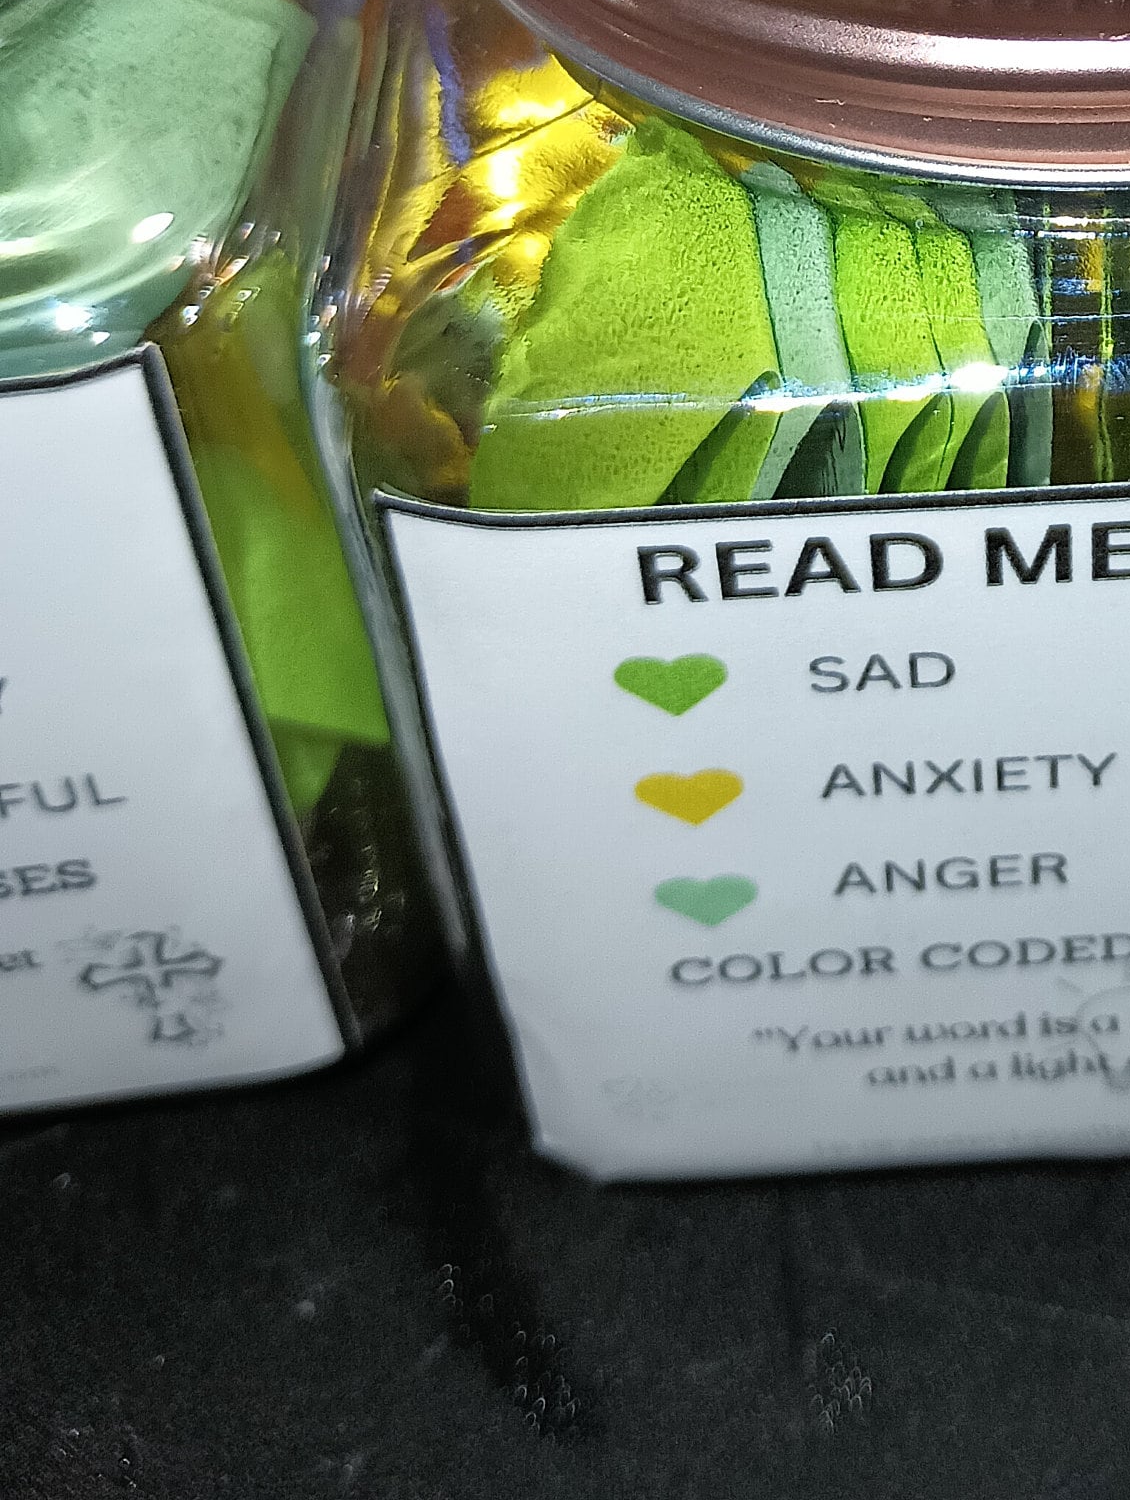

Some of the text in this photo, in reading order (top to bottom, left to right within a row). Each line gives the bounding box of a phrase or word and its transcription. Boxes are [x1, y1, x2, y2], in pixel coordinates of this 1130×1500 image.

[637, 532, 944, 604] READ
[809, 652, 956, 692] SAD
[820, 752, 1117, 798] ANXIETY
[834, 853, 1069, 896] ANGER
[669, 947, 896, 987] COLOR
